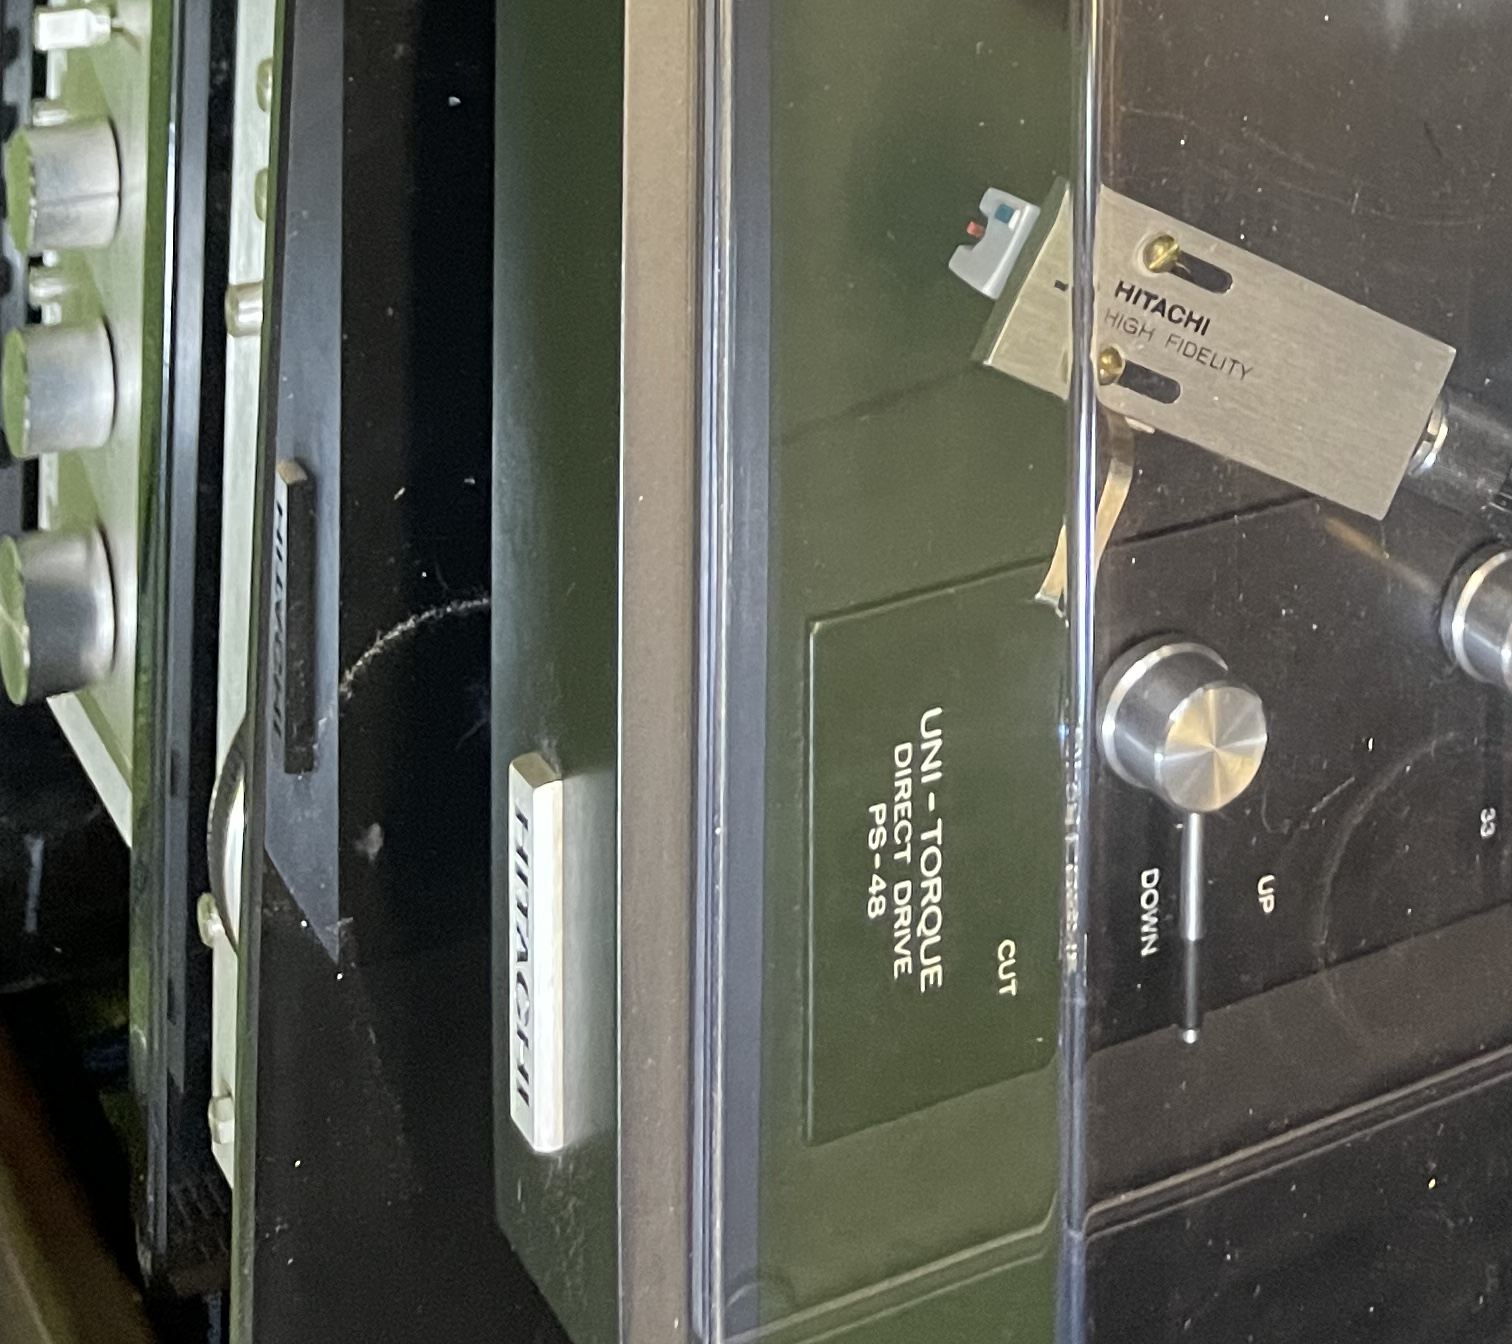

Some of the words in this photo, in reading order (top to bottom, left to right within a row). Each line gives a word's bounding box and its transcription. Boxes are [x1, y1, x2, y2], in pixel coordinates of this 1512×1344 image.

[1104, 308, 1156, 342] HIGH
[1164, 333, 1253, 381] FIDELITY
[1114, 280, 1211, 337] HITACHI
[893, 742, 913, 865] DIRECT
[1479, 807, 1497, 839] 33
[867, 802, 888, 920] PS-48
[1257, 874, 1275, 914] UP
[893, 879, 913, 980] DRIVE
[1139, 868, 1160, 957] DOWN
[513, 802, 530, 1108] HITACHI
[997, 939, 1017, 996] CUT
